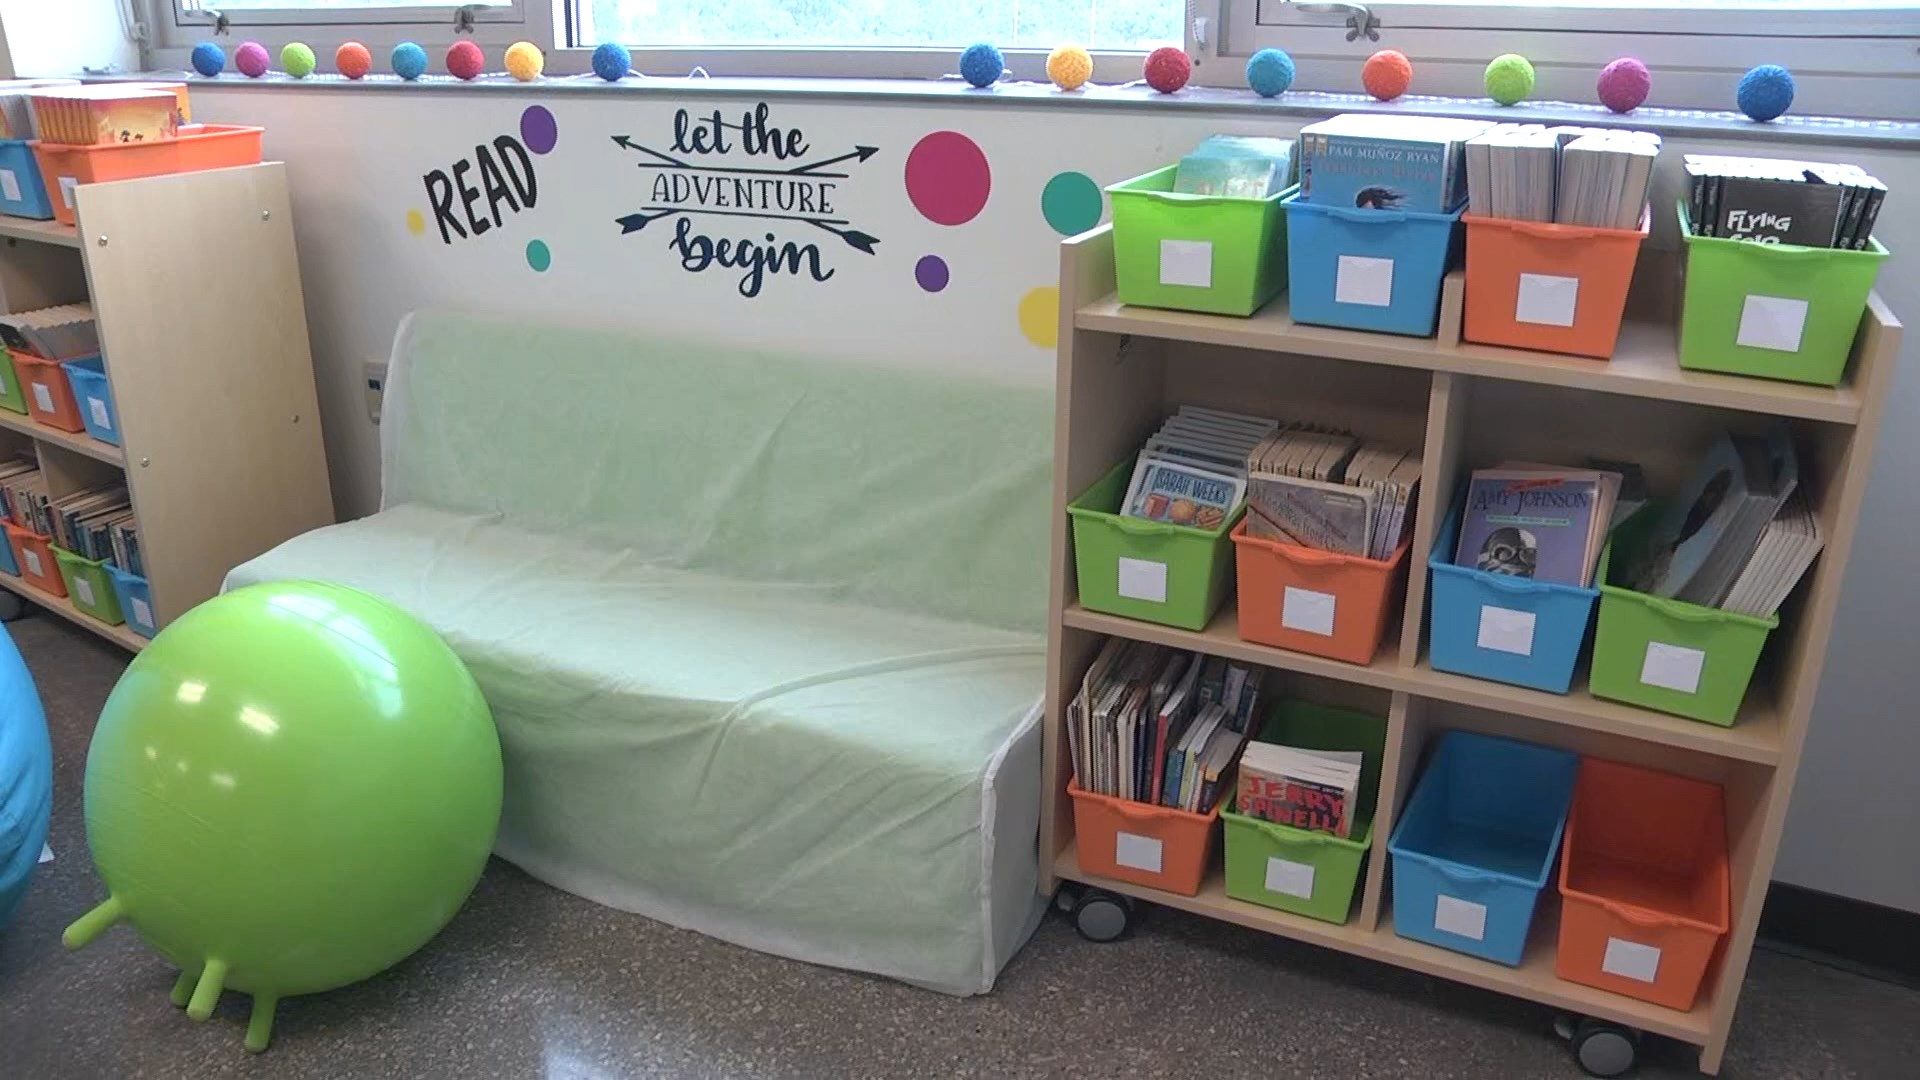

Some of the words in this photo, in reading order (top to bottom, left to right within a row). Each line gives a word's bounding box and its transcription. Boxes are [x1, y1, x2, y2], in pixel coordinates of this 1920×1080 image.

[670, 108, 732, 155] let
[742, 101, 810, 159] the
[1328, 145, 1353, 158] PAM
[1407, 151, 1440, 163] RYAN
[423, 134, 538, 244] READ
[651, 173, 837, 214] ADVENTURE
[1727, 210, 1792, 233] FLYING
[669, 217, 835, 298] begin
[1473, 489, 1508, 511] AMY
[1513, 489, 1588, 516] JOHNSON
[1247, 776, 1345, 815] JERRY
